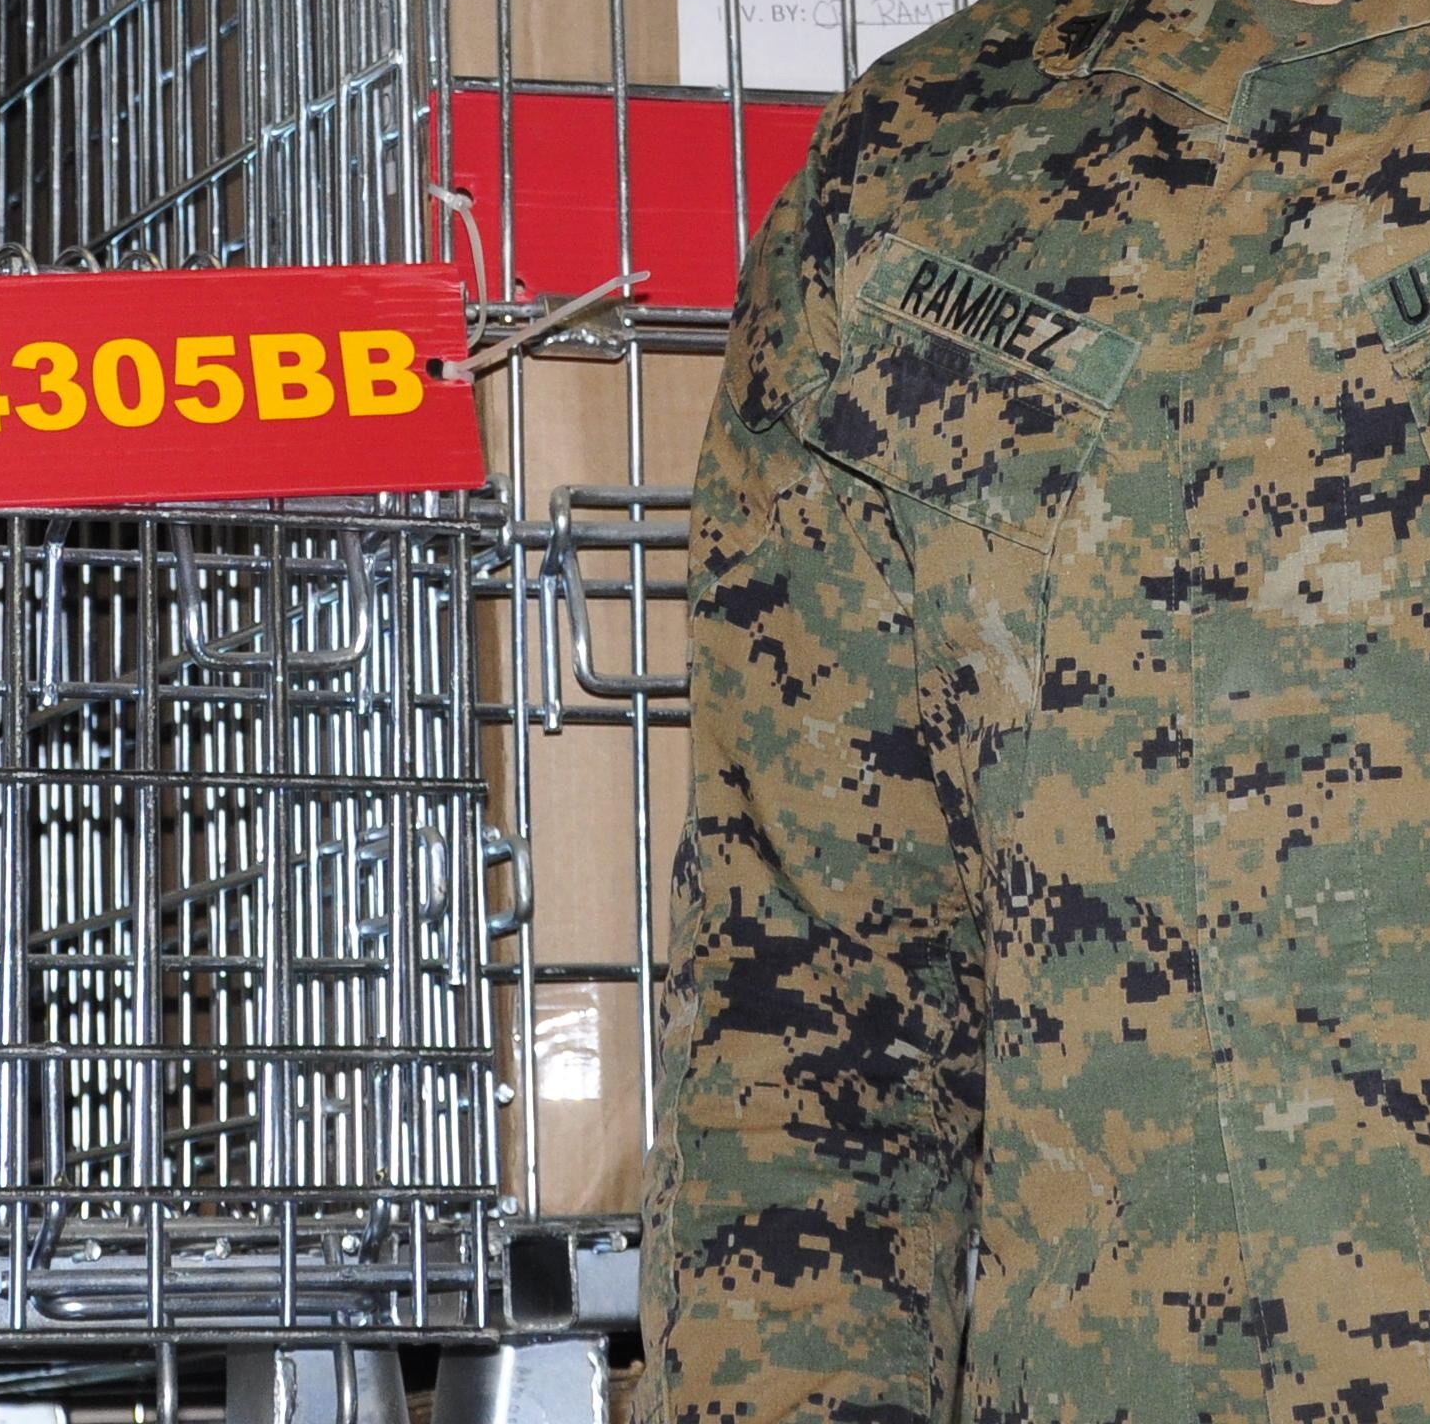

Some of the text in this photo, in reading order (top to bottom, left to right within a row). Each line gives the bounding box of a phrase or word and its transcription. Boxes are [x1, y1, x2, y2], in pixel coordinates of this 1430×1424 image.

[717, 5, 763, 23] IV.
[770, 4, 806, 23] BY:
[898, 258, 1080, 372] RAMIREZ
